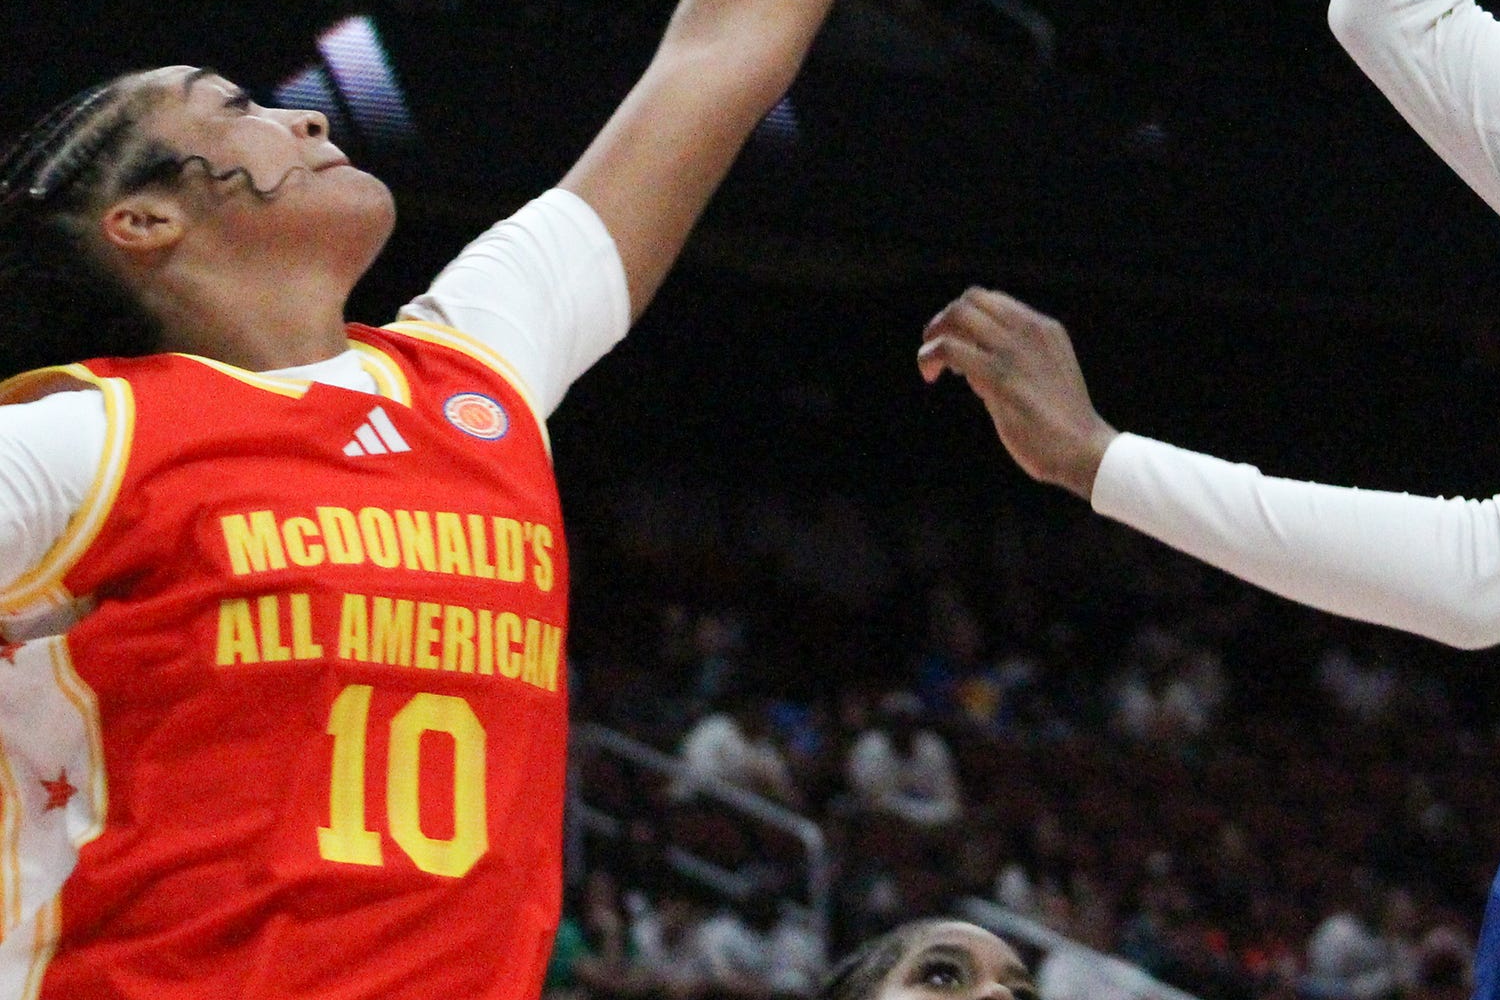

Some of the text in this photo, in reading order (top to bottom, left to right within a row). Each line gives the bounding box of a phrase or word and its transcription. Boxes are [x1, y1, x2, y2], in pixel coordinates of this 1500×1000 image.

[220, 506, 554, 592] McDONALD'S
[215, 593, 562, 692] ALL AMERICAN
[316, 684, 489, 878] 10
